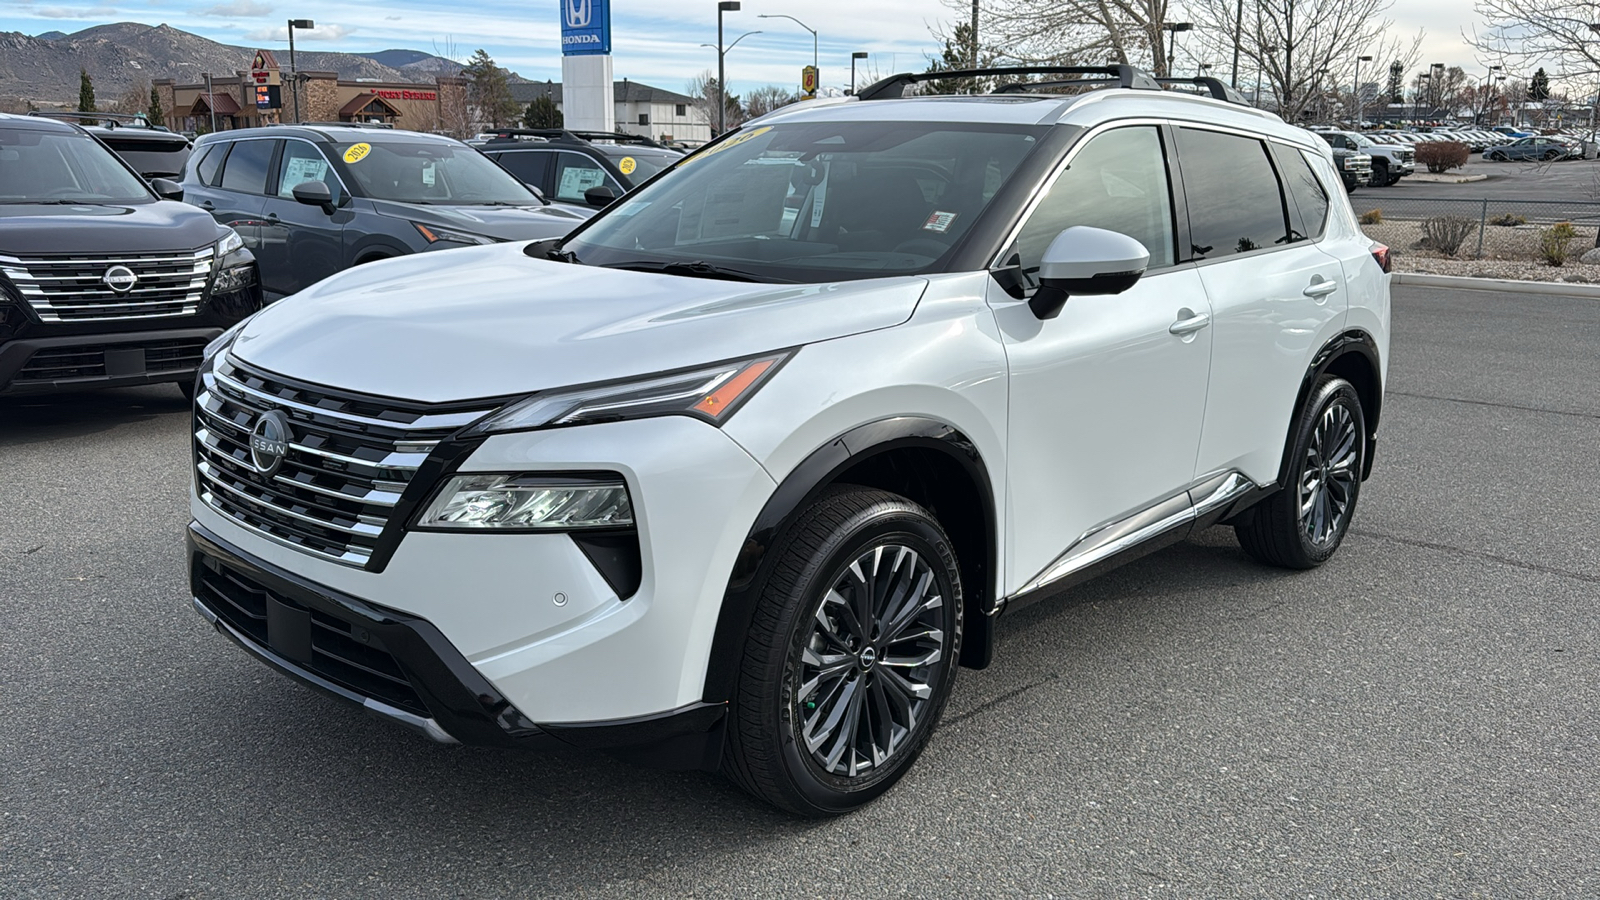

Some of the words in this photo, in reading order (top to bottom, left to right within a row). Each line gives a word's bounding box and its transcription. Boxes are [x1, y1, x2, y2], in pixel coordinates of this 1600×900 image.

[562, 34, 601, 45] HONDA
[805, 74, 814, 87] 8
[402, 89, 437, 101] STRIKE
[347, 144, 368, 161] 2026
[251, 437, 286, 456] SSAN
